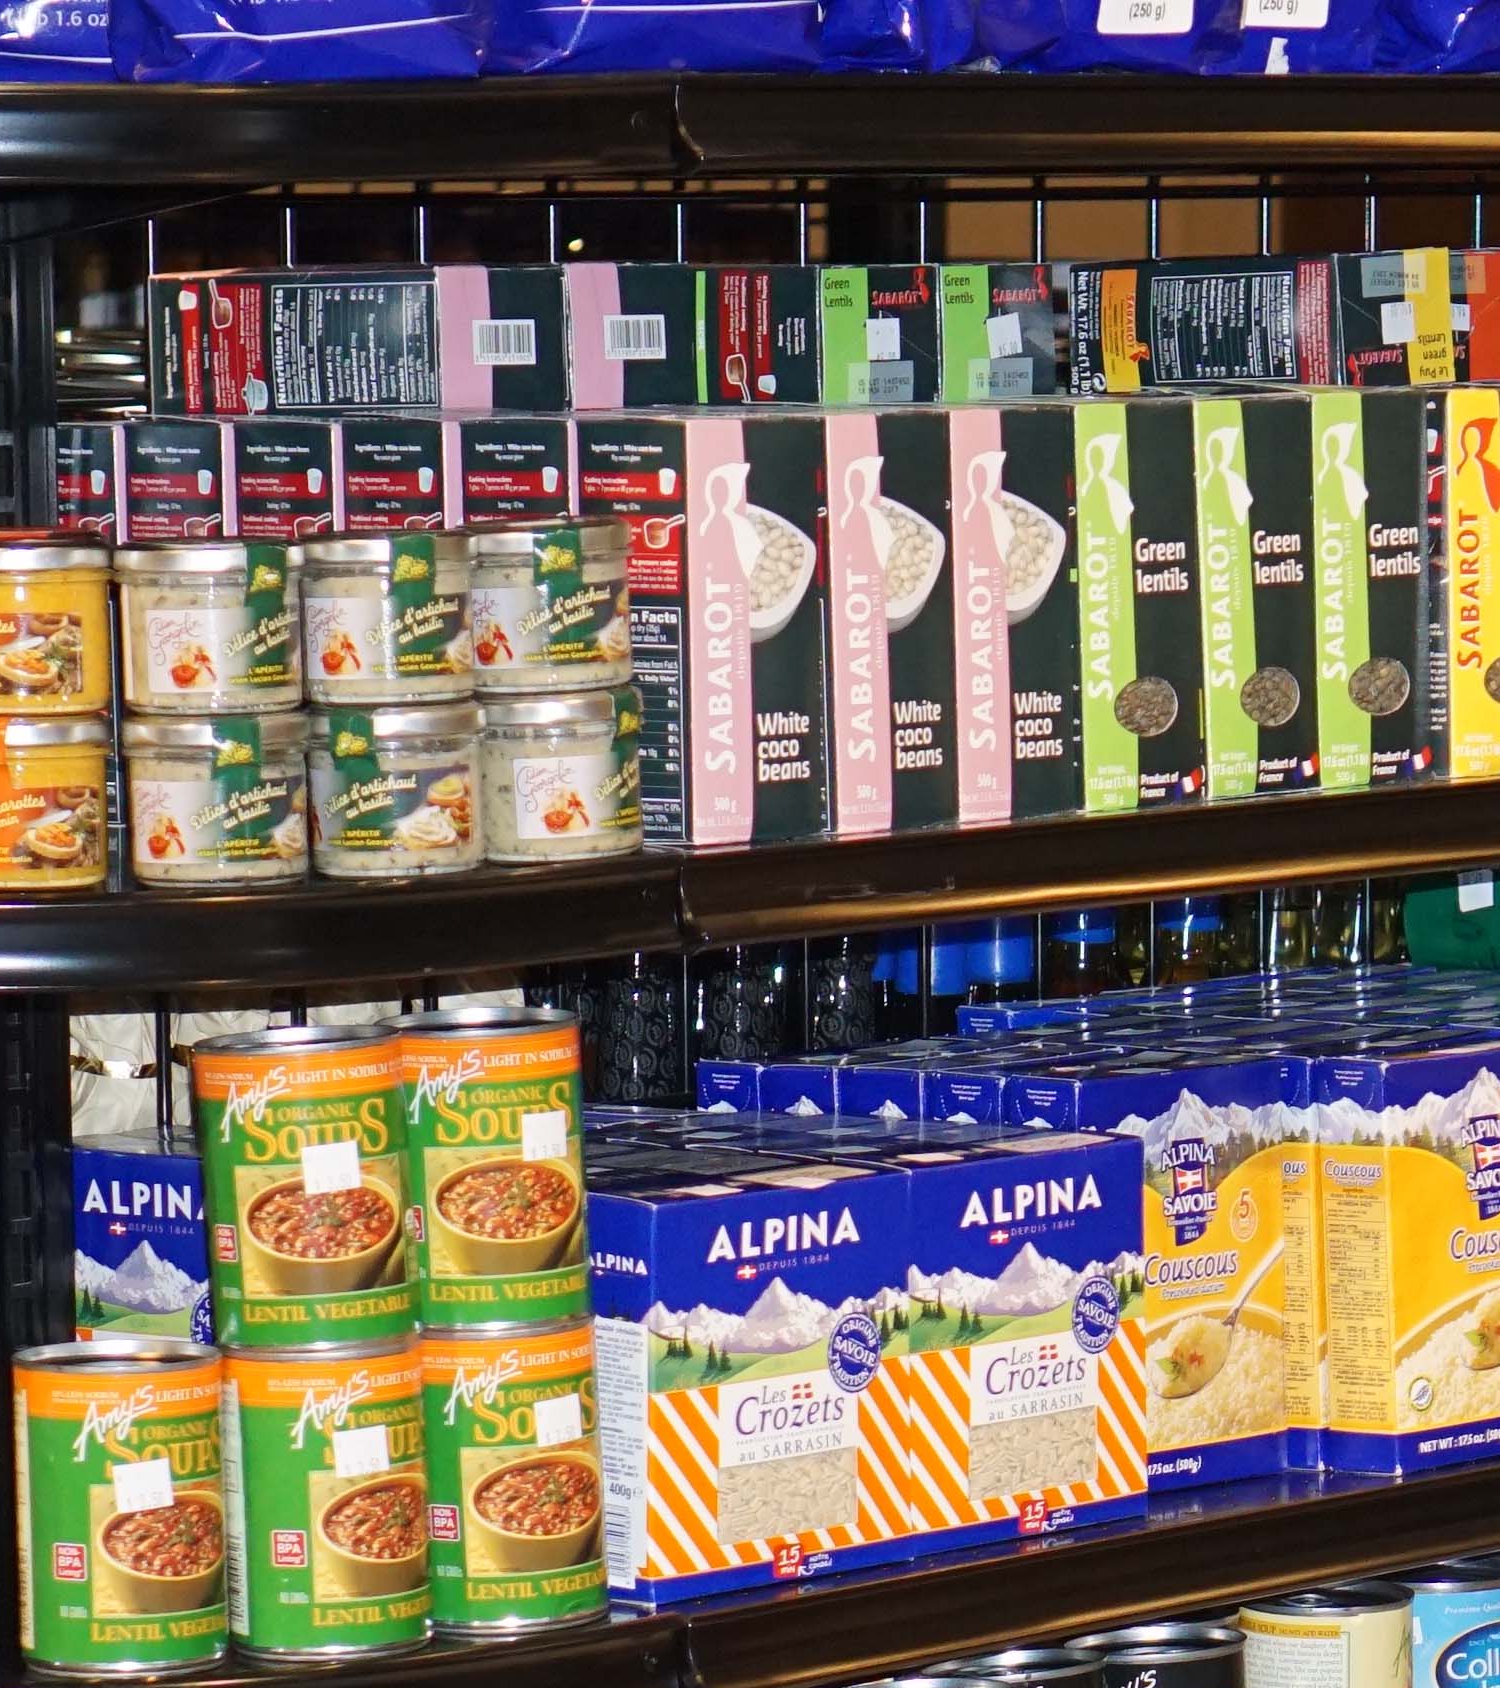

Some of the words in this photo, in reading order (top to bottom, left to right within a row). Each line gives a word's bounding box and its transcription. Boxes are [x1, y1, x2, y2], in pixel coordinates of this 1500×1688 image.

[1129, 2, 1152, 21] (250
[1155, 3, 1166, 21] g)
[824, 276, 851, 291] Green
[824, 294, 853, 309] Lentils
[1136, 538, 1186, 563] Green
[1136, 567, 1189, 593] lentils
[1456, 506, 1484, 669] SABAROT
[1086, 529, 1115, 701] SABAROT
[705, 574, 737, 774] SABAROT
[757, 713, 810, 734] White
[758, 739, 799, 759] coco
[758, 758, 810, 782] beans
[1140, 774, 1166, 789] Product
[1167, 773, 1179, 785] of
[1140, 785, 1166, 797] France
[289, 1069, 329, 1085] LIGHT
[332, 1068, 346, 1082] IN
[349, 1061, 388, 1080] SODIUM
[220, 1065, 288, 1142] Amy's
[273, 1104, 354, 1124] ORGANIC
[1160, 1142, 1215, 1169] ALPINA
[960, 1173, 1102, 1230] ALPINA
[1162, 1190, 1217, 1217] SAVOIE
[706, 1206, 861, 1264] ALPINA
[758, 1259, 797, 1272] DEPUIS
[800, 1253, 830, 1266] 1844
[1144, 1250, 1237, 1288] Couscous
[243, 1302, 310, 1326] LENTIL
[315, 1292, 410, 1321] VEGETABLE
[834, 1339, 877, 1366] SAVOIE
[1009, 1347, 1034, 1366] Les
[985, 1358, 1086, 1397] Crozets
[761, 1384, 787, 1407] Les
[988, 1406, 1007, 1421] au
[1010, 1391, 1083, 1418] SARRASIN
[735, 1394, 845, 1437] Crozets
[739, 1449, 757, 1463] au
[762, 1432, 844, 1460] SARRASIN
